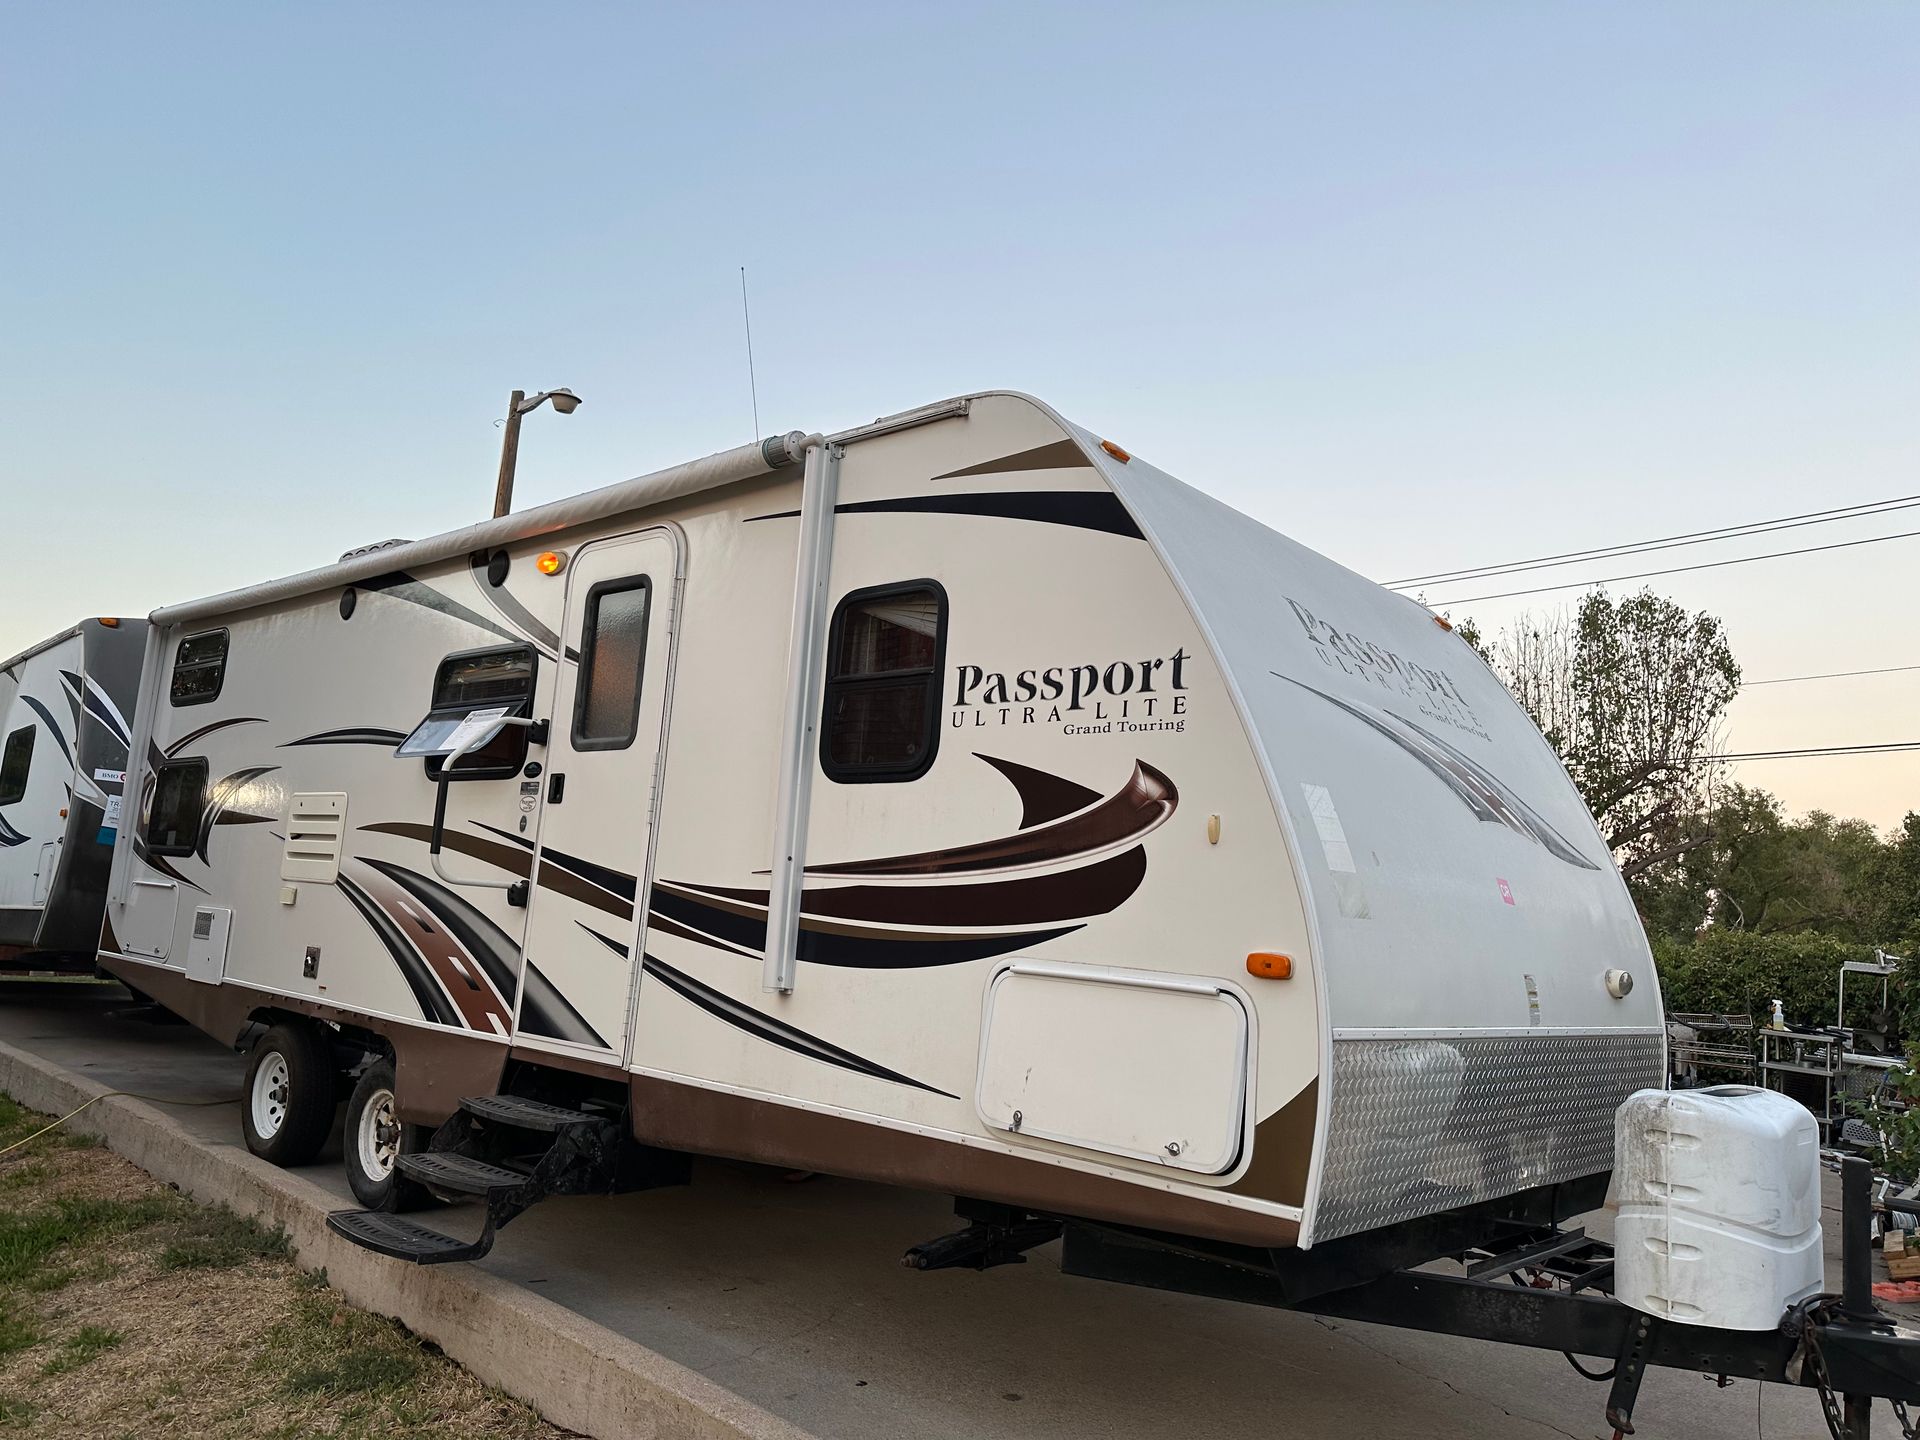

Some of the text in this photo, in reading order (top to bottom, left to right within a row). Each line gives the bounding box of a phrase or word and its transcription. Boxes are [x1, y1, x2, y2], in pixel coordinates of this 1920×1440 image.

[1282, 595, 1470, 708] Passport
[953, 646, 1192, 711] Passport
[952, 696, 1187, 728] ULTRA LITE
[1063, 719, 1186, 736] Grand Touring
